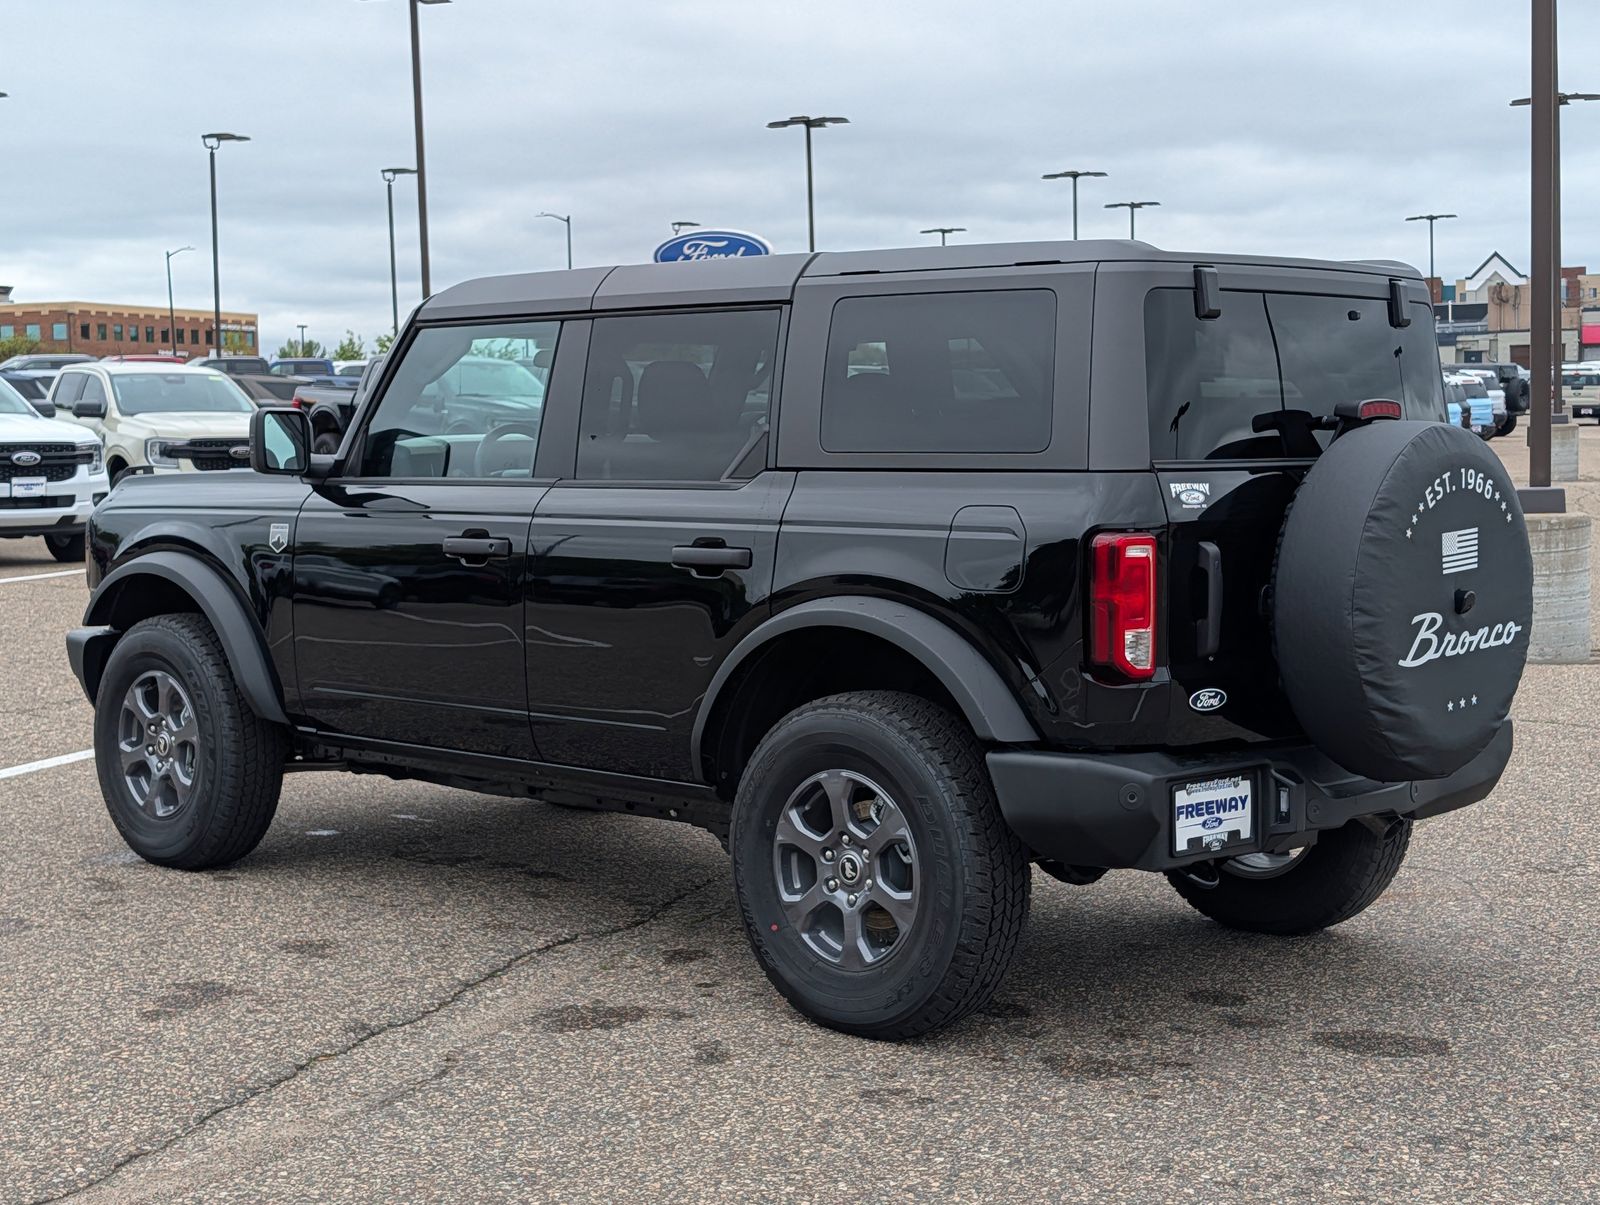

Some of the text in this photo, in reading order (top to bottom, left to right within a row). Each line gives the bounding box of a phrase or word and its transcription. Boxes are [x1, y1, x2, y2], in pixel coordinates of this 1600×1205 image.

[1169, 482, 1210, 498] FREEWAY
[1425, 468, 1493, 509] EST. 1966
[1398, 612, 1522, 668] Bronco
[1197, 692, 1221, 707] Ford
[1176, 795, 1248, 821] FREEWAY
[1205, 818, 1220, 829] Ford
